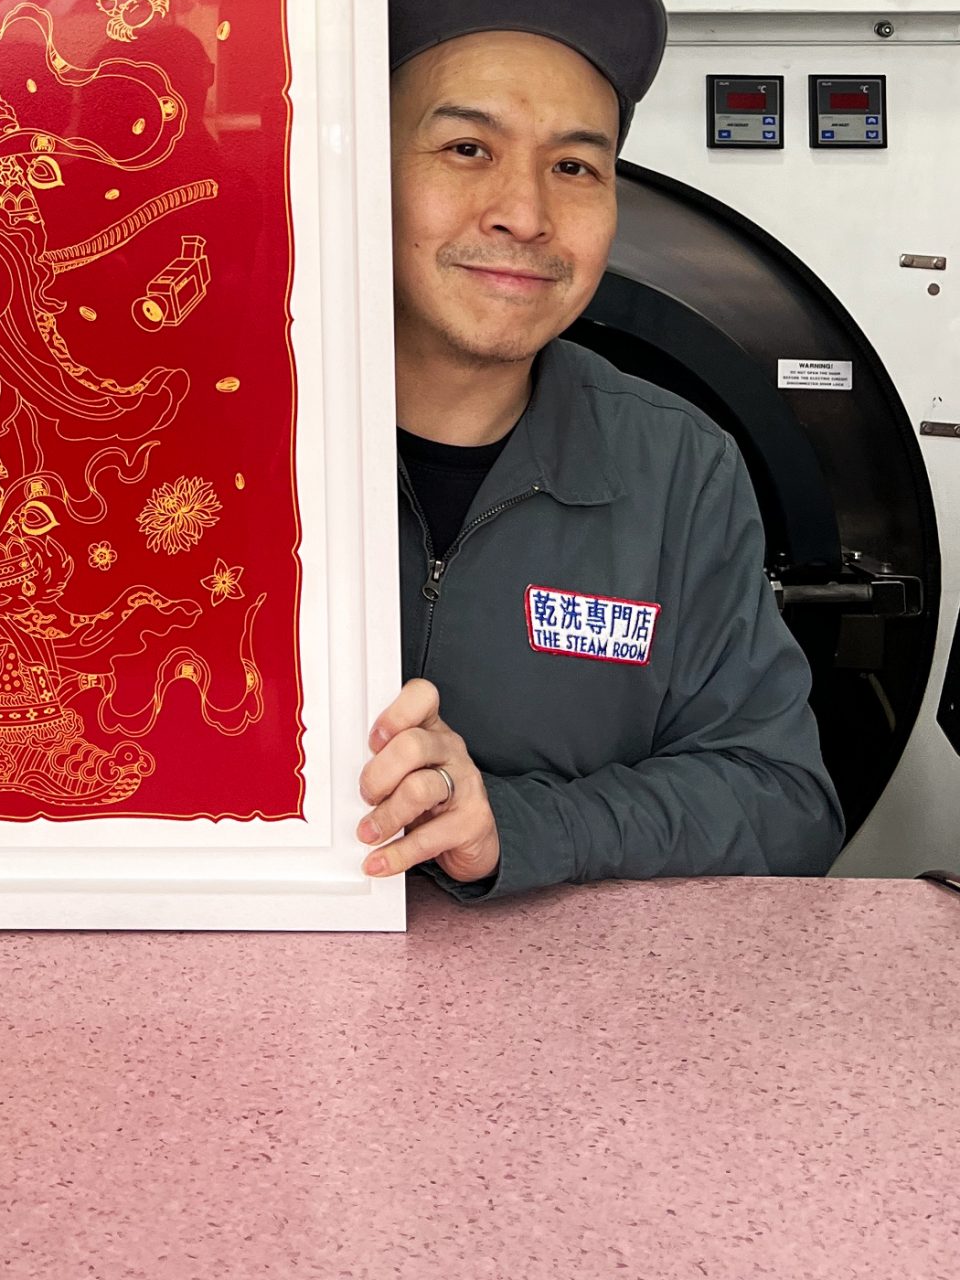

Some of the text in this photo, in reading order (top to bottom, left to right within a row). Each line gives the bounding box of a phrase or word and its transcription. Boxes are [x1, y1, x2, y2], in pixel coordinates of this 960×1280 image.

[535, 629, 648, 661] THE STEAM ROOM
